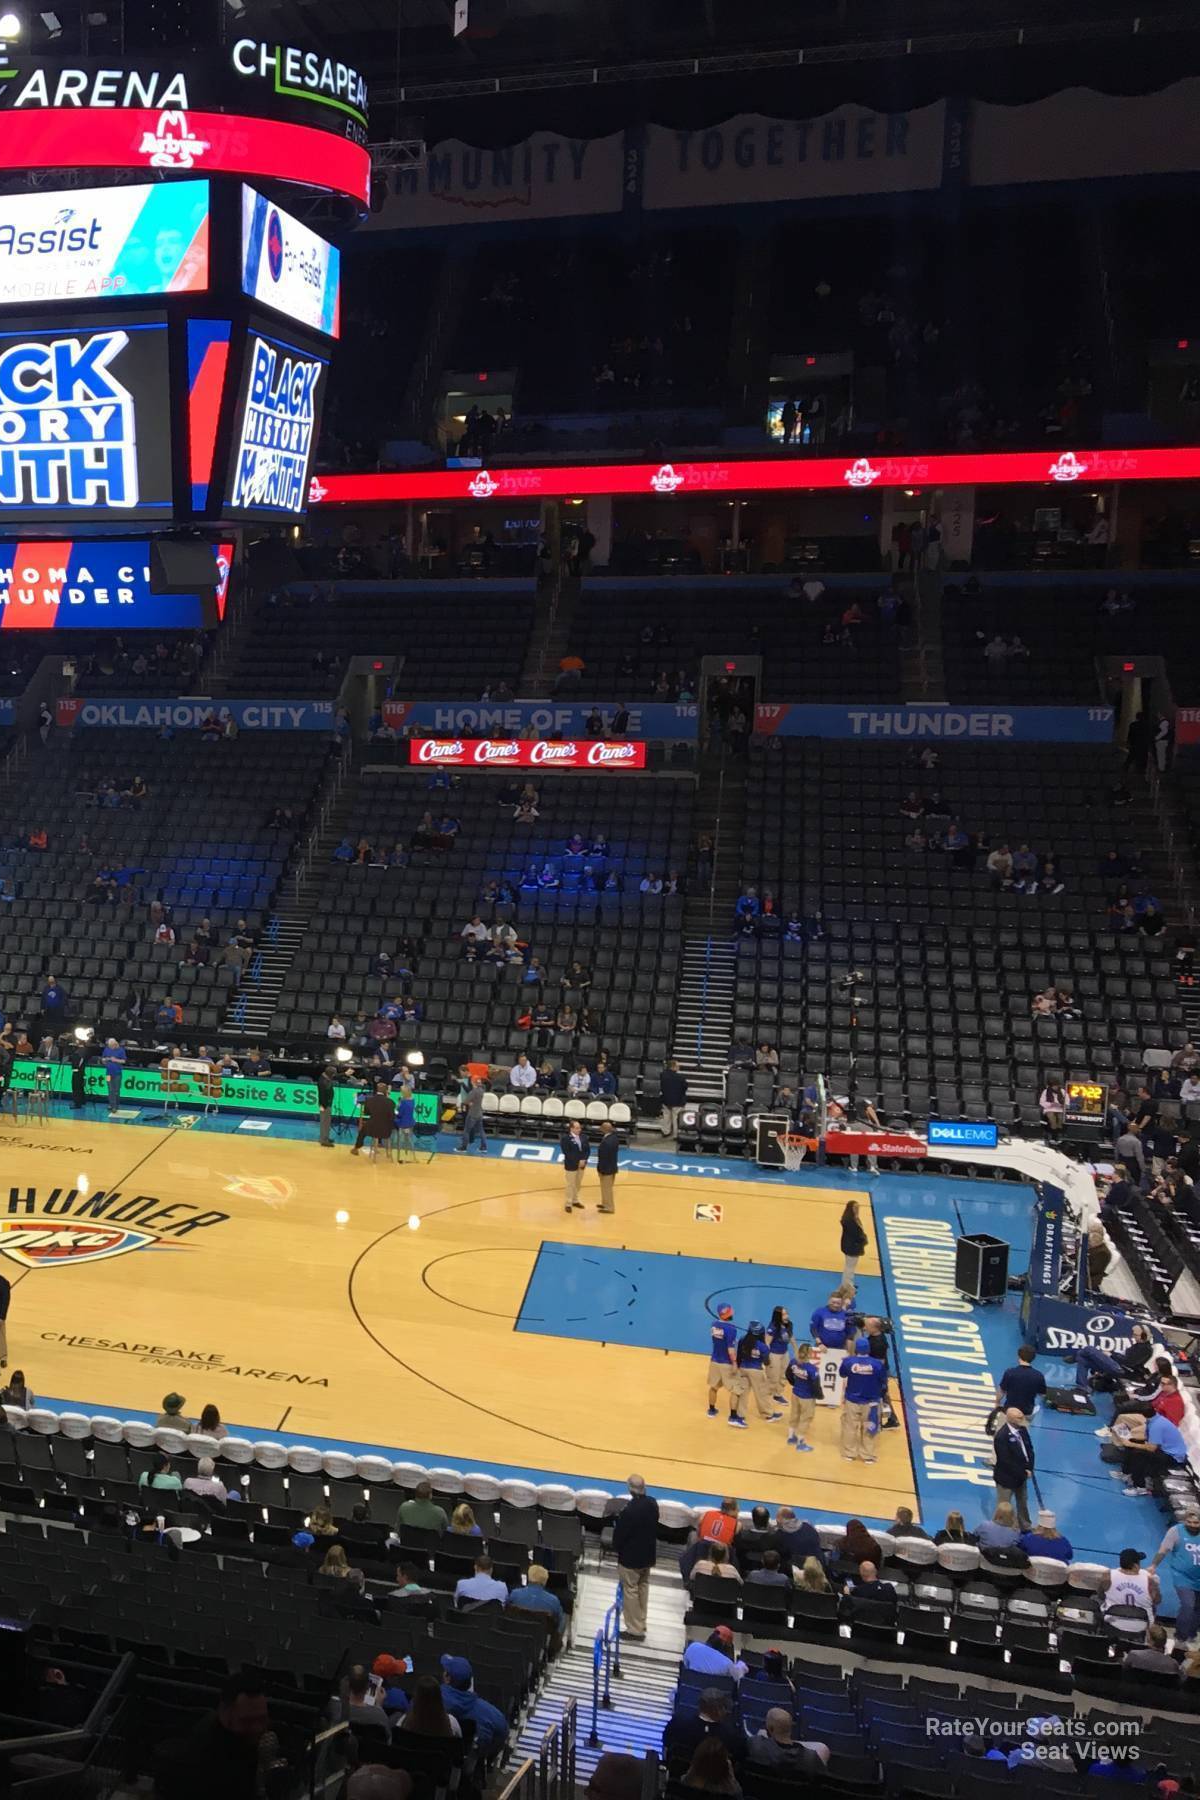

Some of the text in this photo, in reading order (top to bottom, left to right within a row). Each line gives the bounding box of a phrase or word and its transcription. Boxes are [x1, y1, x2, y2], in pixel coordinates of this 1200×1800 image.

[14, 69, 189, 109] ARENA
[676, 112, 909, 172] TOGETHER
[626, 149, 638, 193] 324
[3, 279, 77, 299] MOBILE
[85, 276, 126, 292] APP
[253, 341, 320, 418] BLACK
[246, 407, 310, 454] HISTORY
[58, 700, 77, 711] 115
[242, 706, 306, 727] CITY
[313, 702, 333, 713] 115
[385, 703, 405, 715] 116
[674, 705, 697, 717] 116
[757, 706, 781, 718] 117
[1087, 709, 1113, 721] 117
[434, 708, 521, 731] HOME
[530, 708, 573, 729] OF
[848, 712, 1014, 737] THUNDER
[418, 739, 466, 761] Cane's
[473, 740, 521, 762] Cane's
[530, 741, 578, 763] Cane's
[587, 742, 637, 764] Cane's
[273, 1087, 287, 1104] &
[932, 1127, 993, 1141] DELL EMC
[17, 1143, 94, 1155] ARENA
[1042, 1223, 1055, 1285] DRAFTKINGS
[40, 1331, 226, 1364] CHESAPEAKE
[1046, 1326, 1138, 1352] SPALDIN
[883, 1216, 998, 1488] OKLAHOMA CITY THUNDER
[140, 1357, 330, 1388] ENERGY ARENA
[824, 1362, 837, 1392] GET
